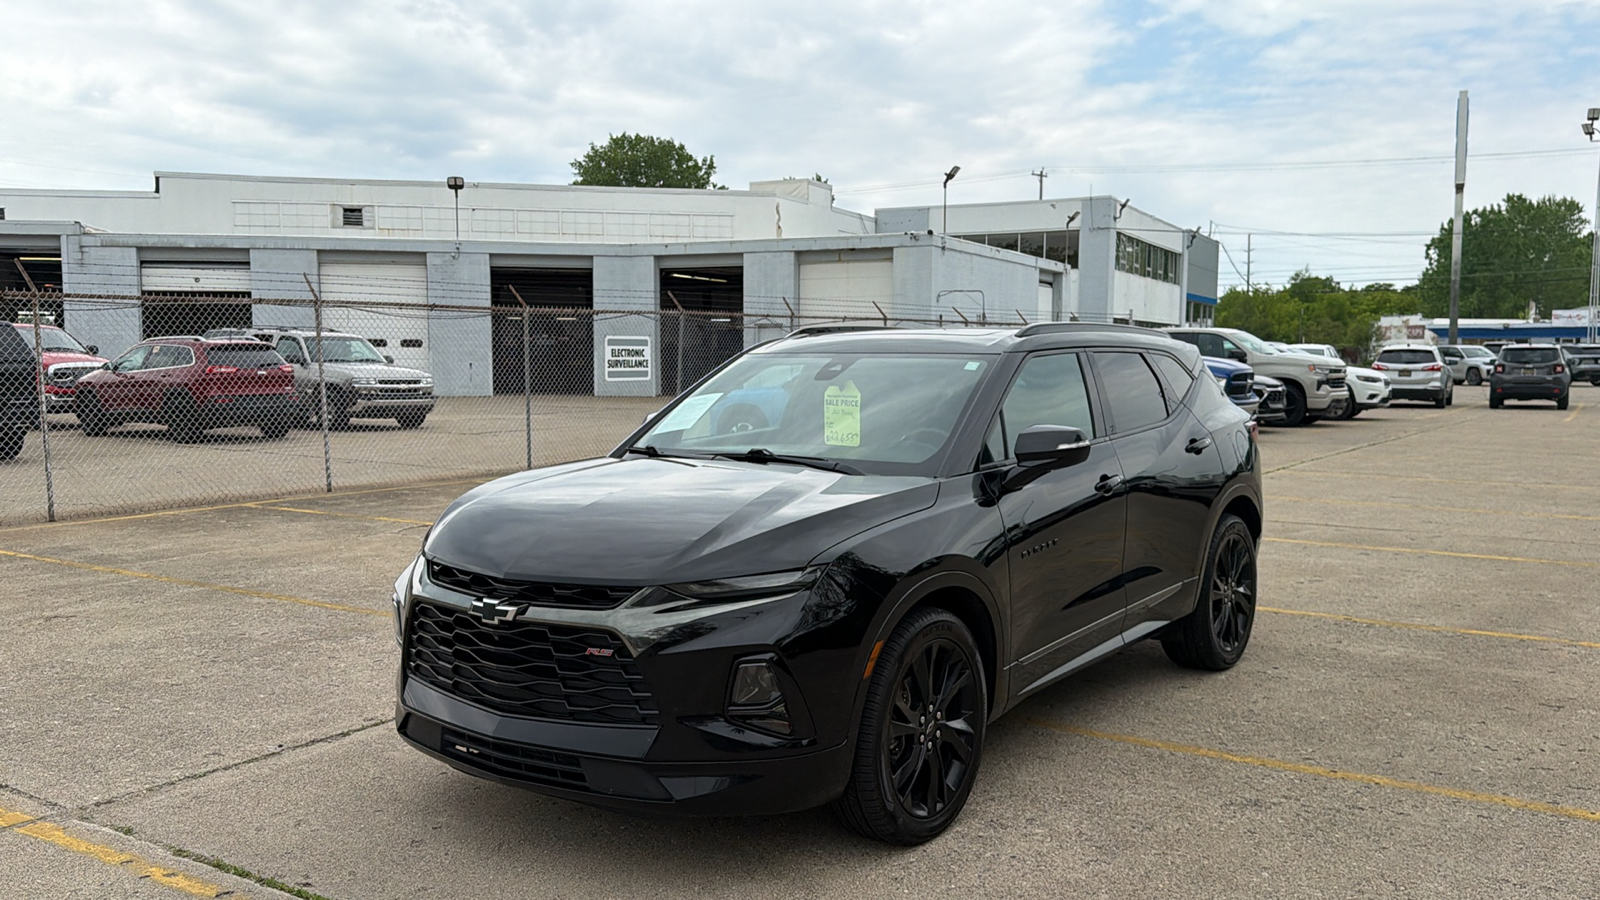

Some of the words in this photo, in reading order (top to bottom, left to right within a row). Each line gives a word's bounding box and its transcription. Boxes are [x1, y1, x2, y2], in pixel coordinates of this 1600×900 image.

[611, 348, 645, 358] ELECTRONIC
[607, 359, 649, 369] SURVEILLANCE
[825, 398, 840, 407] SALE
[840, 399, 859, 408] PRICE
[585, 647, 614, 657] RS
